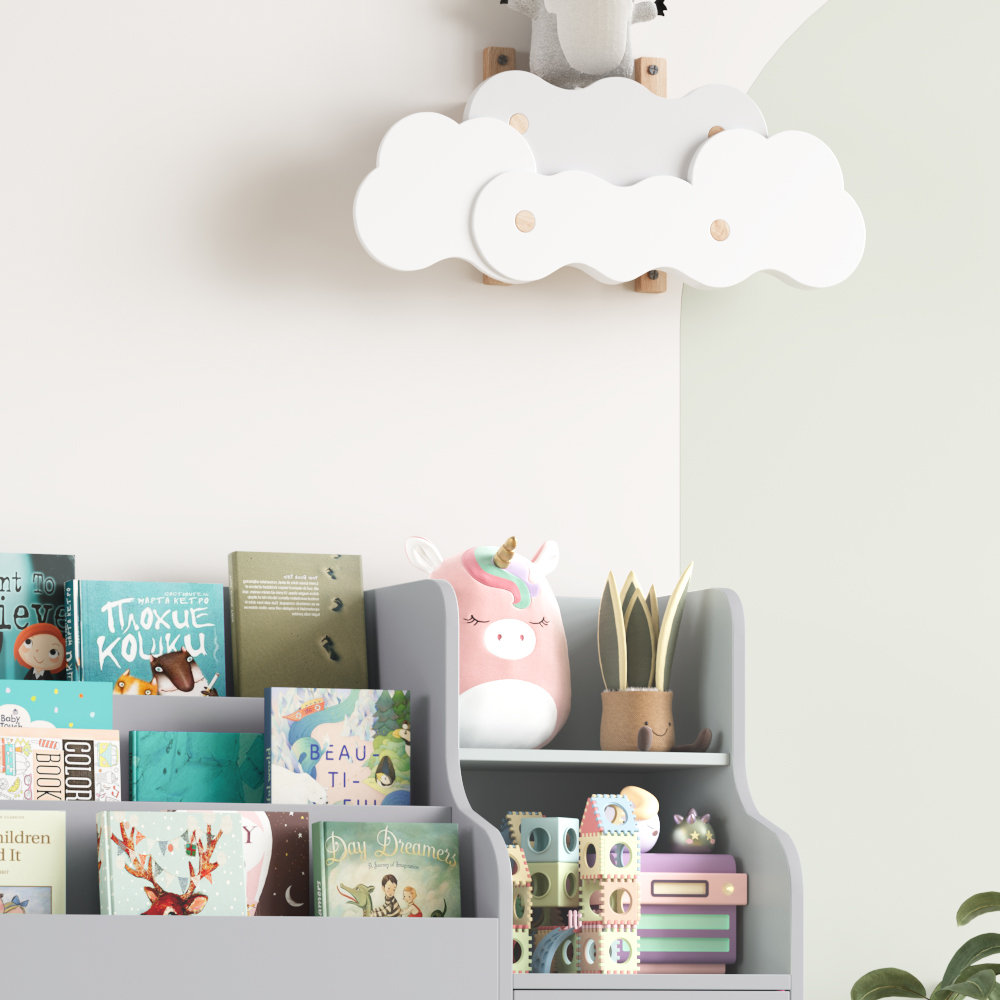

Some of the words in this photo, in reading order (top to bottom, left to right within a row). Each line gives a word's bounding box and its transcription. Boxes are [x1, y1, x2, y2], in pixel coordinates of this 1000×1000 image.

[33, 573, 55, 594] To
[138, 597, 170, 605] МАРТА
[173, 597, 209, 605] КЕТРО
[0, 714, 21, 724] Baby
[310, 744, 380, 761] BEAU-
[36, 752, 62, 800] BOOK
[63, 741, 93, 801] COLOR
[328, 771, 360, 788] TI-
[9, 848, 22, 861] It
[325, 831, 367, 866] Day
[374, 825, 457, 868] Dreamers
